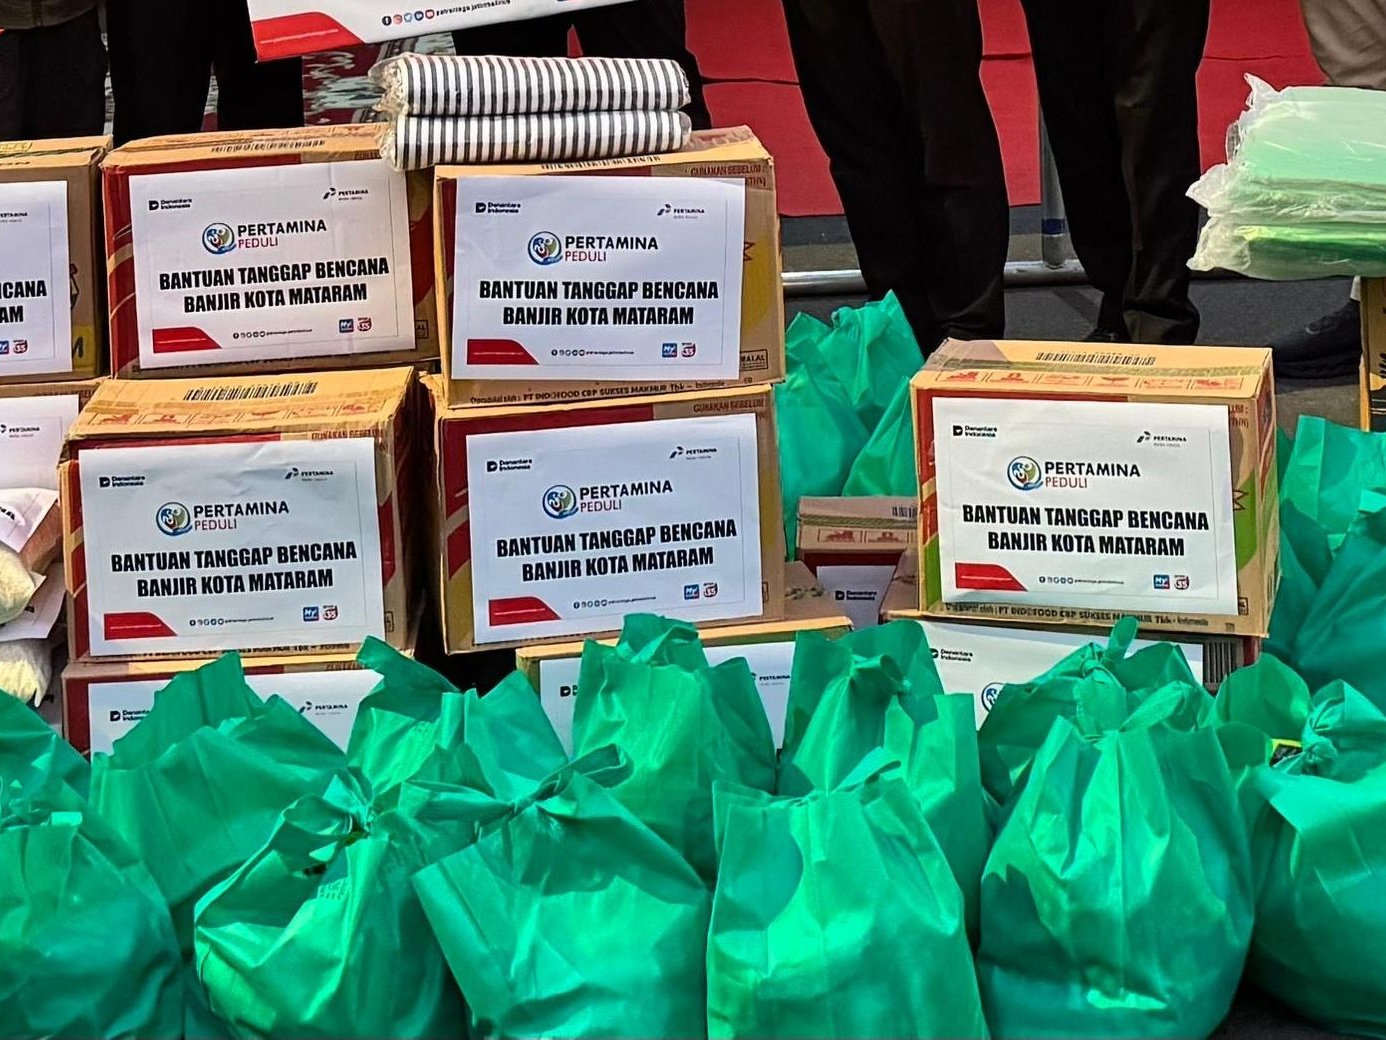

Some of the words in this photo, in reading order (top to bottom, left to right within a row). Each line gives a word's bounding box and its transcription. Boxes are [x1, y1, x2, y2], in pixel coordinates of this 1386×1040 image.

[237, 219, 327, 237] PERTAMINA
[238, 237, 278, 249] PEDULI
[565, 236, 659, 250] PERTAMINA
[565, 250, 607, 262] PEDULI
[159, 268, 235, 290] BANTUAN
[238, 263, 312, 284] TANGGAP
[315, 257, 389, 279] BENCANA
[184, 292, 241, 313] BANJIR
[244, 288, 285, 309] KOTA
[289, 283, 367, 305] MATARAM
[479, 280, 558, 300] BANTUAN
[562, 281, 638, 300] TANGGAP
[642, 281, 719, 300] BENCANA
[503, 307, 562, 326] BANJIR
[566, 307, 609, 325] KOTA
[613, 307, 694, 325] MATARAM
[1045, 461, 1140, 478] PERTAMINA
[579, 480, 672, 500] PERTAMINA
[1045, 477, 1088, 489] PEDULI
[194, 501, 289, 518] PERTAMINA
[580, 501, 622, 512] PEDULI
[194, 519, 237, 531] PEDULI
[963, 504, 1041, 525] BANTUAN
[1045, 508, 1124, 528] TANGGAP
[1128, 510, 1209, 530] BENCANA
[497, 534, 576, 557] BANTUAN
[579, 527, 656, 550] TANGGAP
[660, 519, 737, 542] BENCANA
[988, 532, 1047, 551] BANJIR
[1051, 533, 1095, 553] KOTA
[1099, 536, 1185, 556] MATARAM
[111, 552, 191, 572] BANTUAN
[194, 547, 273, 567] TANGGAP
[277, 541, 357, 563] BENCANA
[522, 560, 582, 582] BANJIR
[586, 555, 629, 577] KOTA
[633, 547, 714, 572] MATARAM
[137, 576, 197, 597] BANJIR
[202, 573, 245, 594] KOTA
[249, 569, 333, 592] MATARAM
